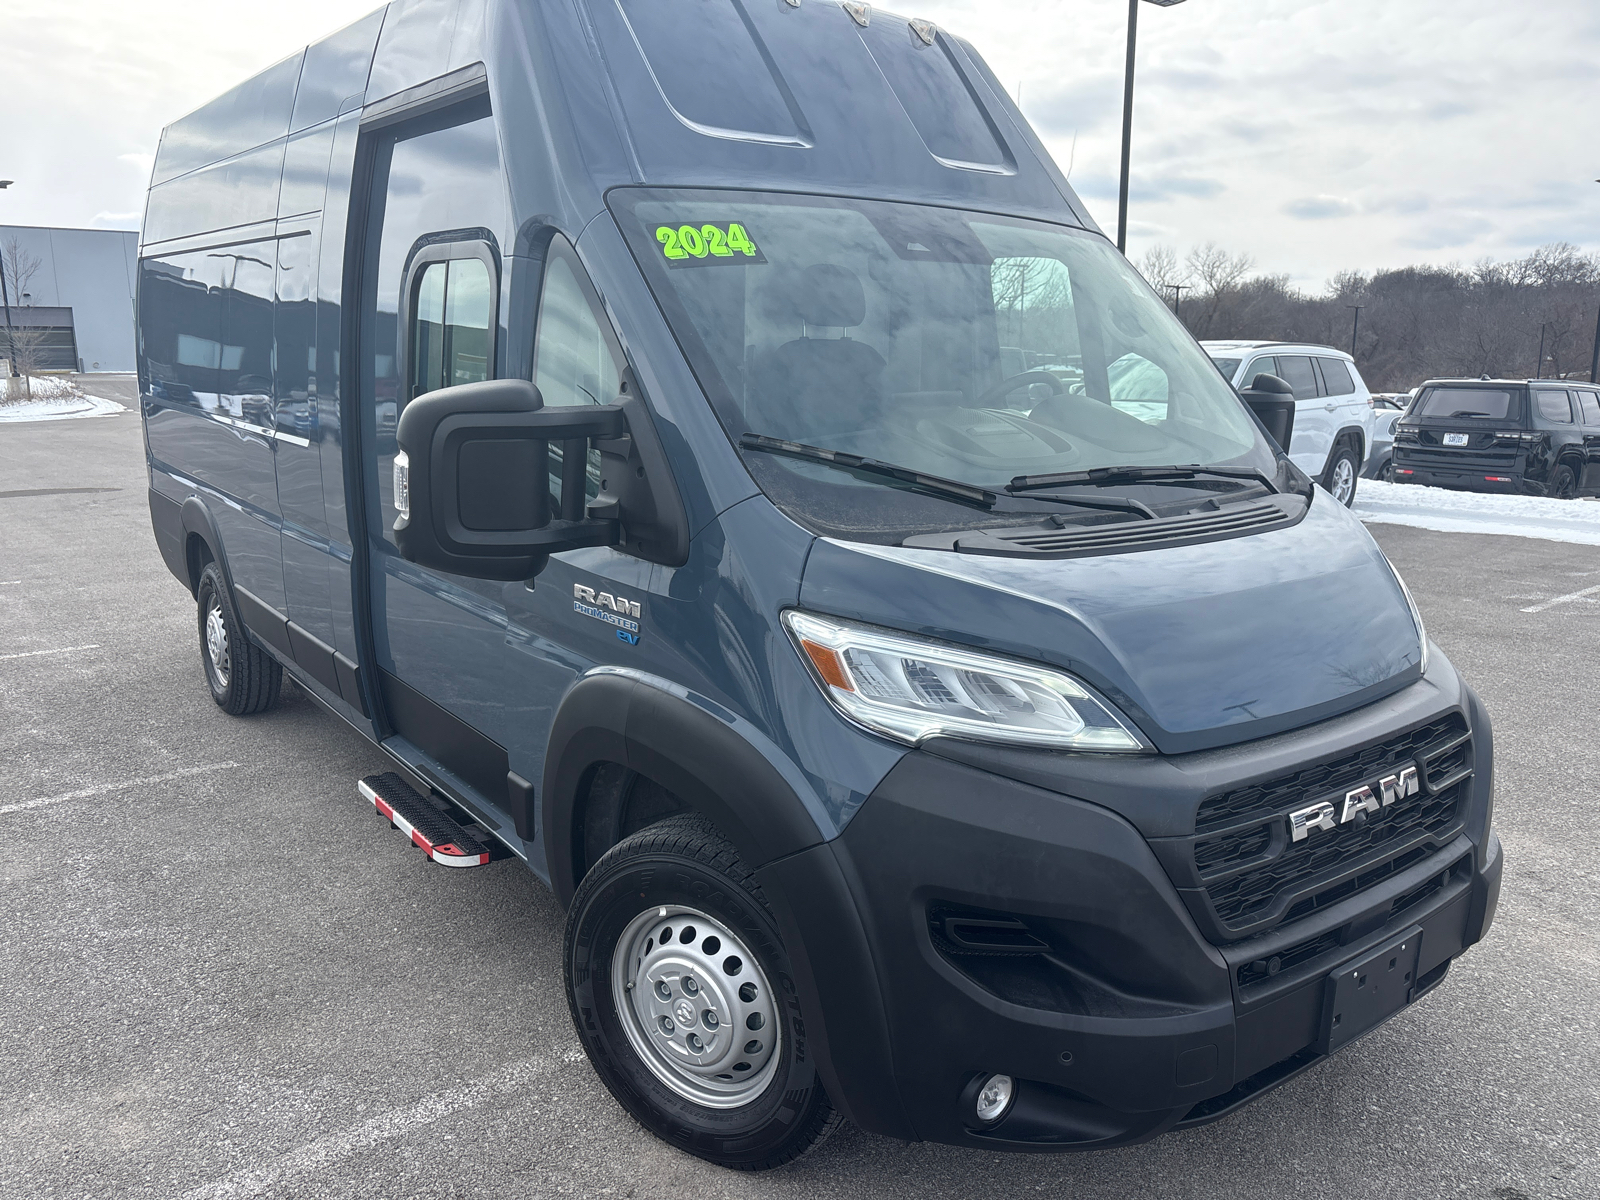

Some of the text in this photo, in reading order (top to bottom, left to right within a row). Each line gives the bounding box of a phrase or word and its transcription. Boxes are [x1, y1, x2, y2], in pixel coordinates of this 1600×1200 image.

[656, 223, 756, 259] 2024
[574, 583, 641, 619] RAM
[1289, 766, 1419, 843] RAM
